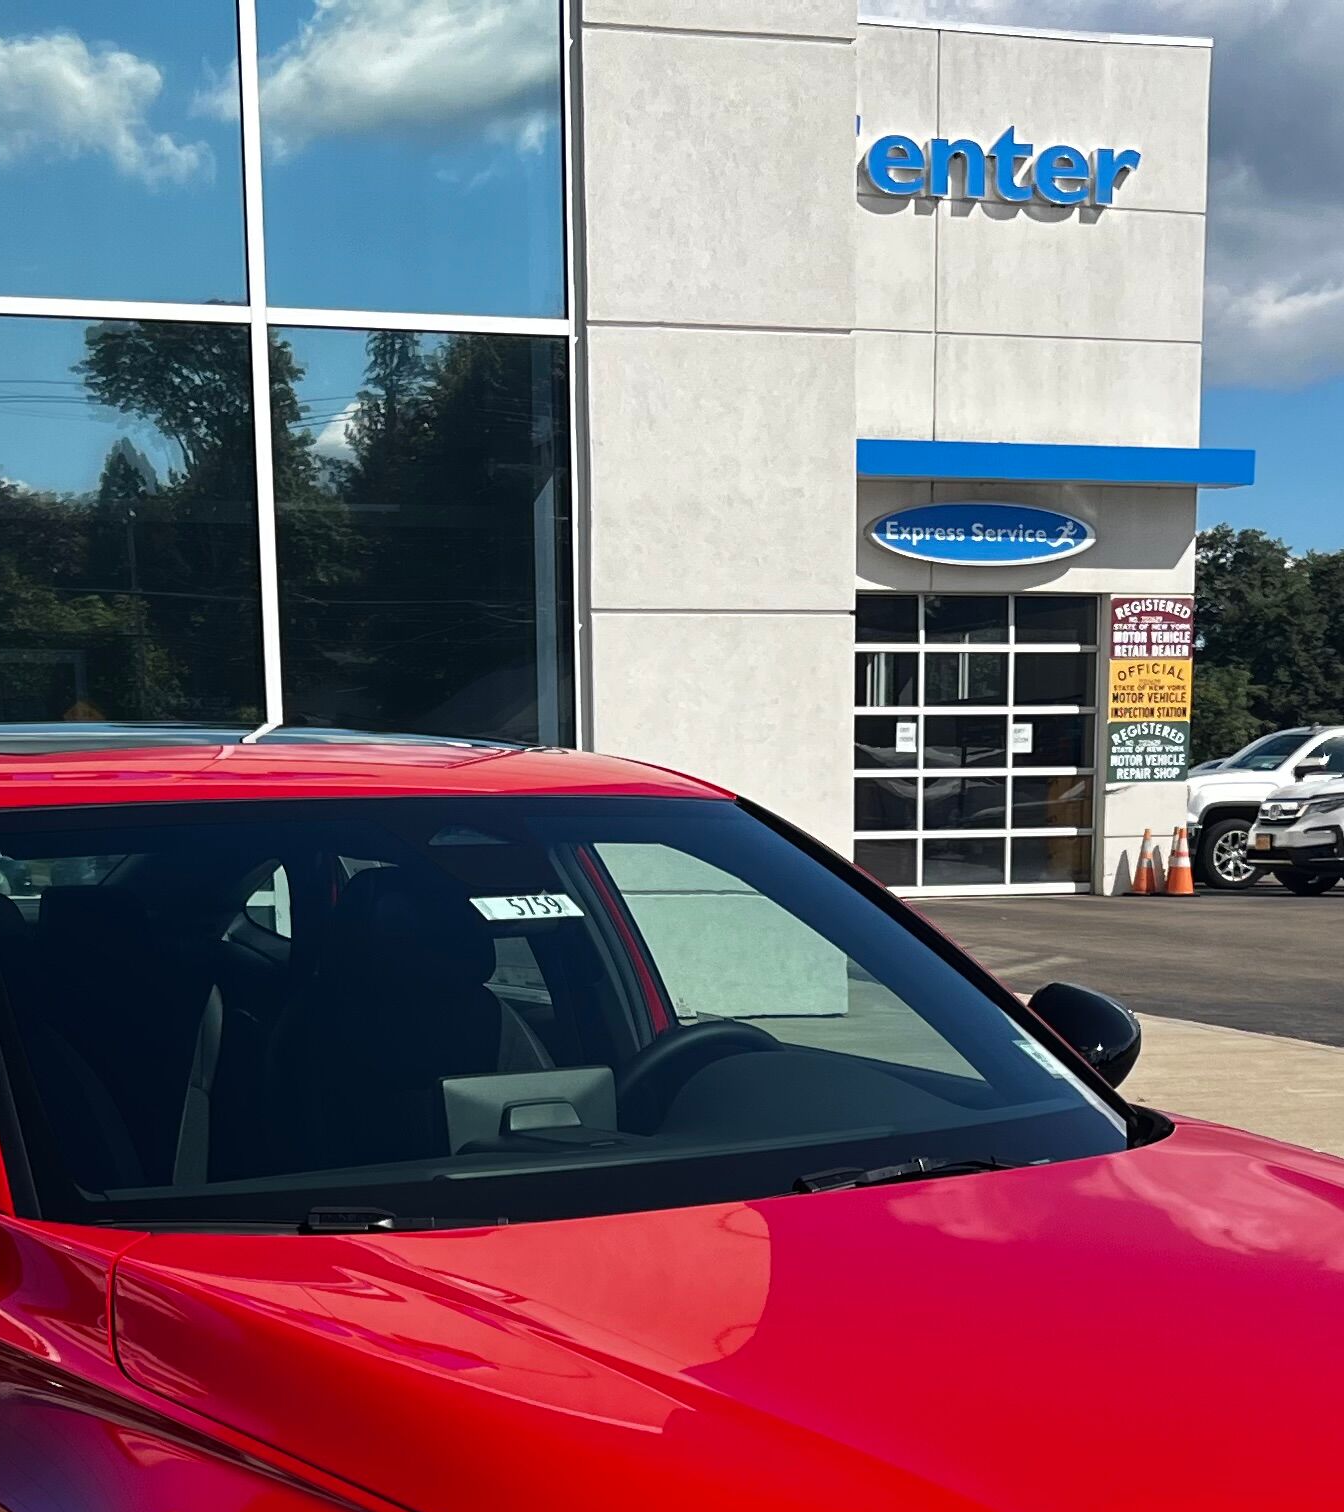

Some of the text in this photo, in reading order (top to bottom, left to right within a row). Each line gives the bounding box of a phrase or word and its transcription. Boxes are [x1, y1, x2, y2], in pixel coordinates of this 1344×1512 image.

[856, 115, 1142, 205] enter
[885, 521, 1047, 545] Express Service
[1114, 599, 1191, 620] REGISTERED
[1113, 631, 1191, 643] MOTOR VEHICLE
[1114, 645, 1189, 657] RETAIL DEALER
[1117, 663, 1185, 681] OFFICIAL
[1112, 692, 1187, 703] MOTOR VEHICLE
[1111, 707, 1187, 718] INSPECTION STATION
[1111, 722, 1185, 745] REGISTERED
[1110, 754, 1186, 766] MOTOR VEHICLE
[1116, 767, 1180, 779] REPAIR SHOP
[505, 896, 563, 916] 5759
